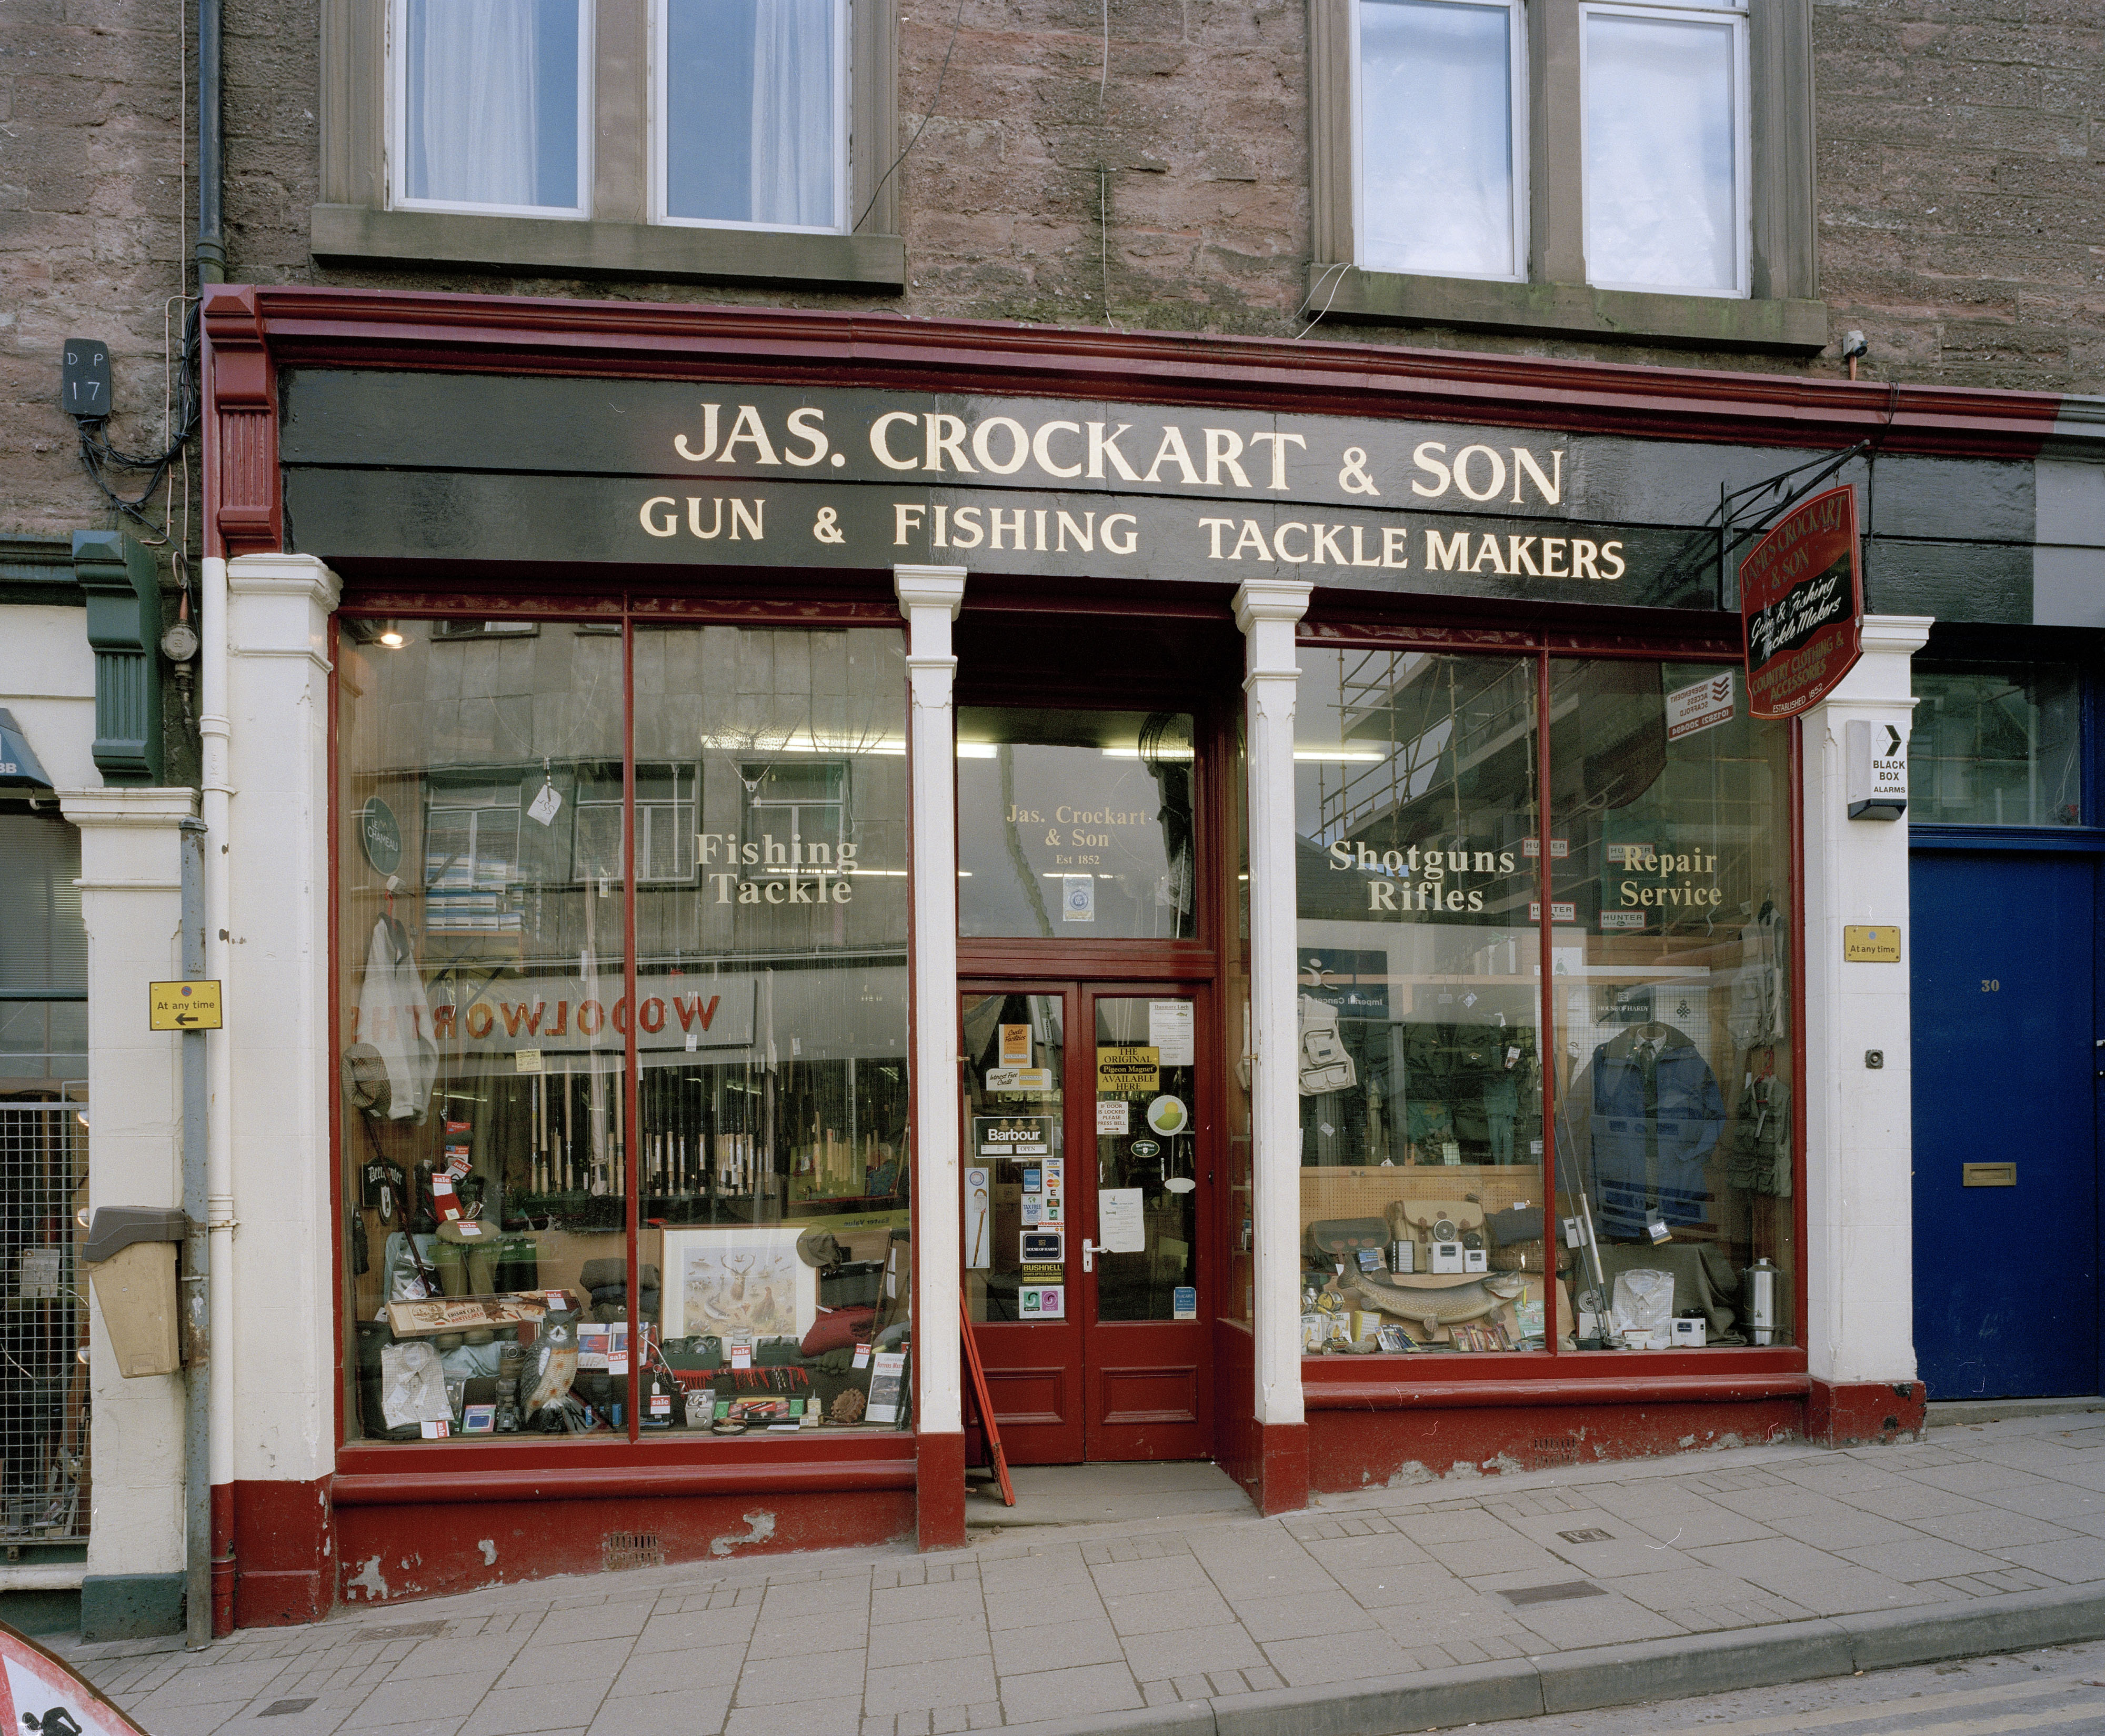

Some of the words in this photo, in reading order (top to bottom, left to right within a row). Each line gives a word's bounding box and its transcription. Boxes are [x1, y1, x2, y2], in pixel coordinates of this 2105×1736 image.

[674, 404, 845, 467] JAS.
[869, 412, 1306, 490] CROCKART
[1339, 447, 1380, 495] &
[1412, 441, 1563, 505] SON
[639, 497, 765, 540] GUN
[814, 507, 845, 544] &
[893, 504, 1137, 555] FISHING
[1198, 518, 1407, 569] TACKLE
[1425, 530, 1625, 580] MAKERS
[1744, 538, 1777, 598] JAMES
[1778, 495, 1846, 554] CROCKART
[1783, 543, 1809, 583] SON
[1777, 601, 1786, 623] &
[1791, 576, 1838, 619] Fishing
[1761, 618, 1796, 659] Tackle
[1797, 597, 1840, 634] Makers
[1752, 661, 1789, 696] COUNTRY
[1791, 636, 1833, 674] CLOTHING
[1836, 631, 1844, 649] &
[1770, 659, 1826, 704] ACCESSORIES
[1773, 695, 1806, 713] ESTABLISHED
[1809, 683, 1823, 699] 1852
[1873, 760, 1905, 769] BLACK
[1879, 772, 1899, 780] BOX
[1006, 805, 1045, 822] Jas.
[1056, 806, 1147, 825] Crockart
[368, 826, 398, 852] CHAMEAU
[1045, 828, 1060, 846] &
[1072, 829, 1109, 847] Son
[695, 834, 858, 872] Fishing
[1056, 855, 1072, 864] Est
[1078, 855, 1100, 865] 1852
[1329, 841, 1515, 880] Shotguns
[1623, 847, 1718, 877] Repair
[709, 874, 851, 904] Tackle
[1367, 881, 1483, 912] Rifles
[1620, 881, 1722, 907] Service
[1860, 946, 1876, 955] any
[1981, 979, 1999, 992] 30
[157, 1001, 168, 1010] At
[172, 1001, 188, 1012] any
[192, 1000, 215, 1009] time
[988, 1129, 1040, 1141] Barbour
[453, 1161, 468, 1172] sale
[437, 1422, 446, 1437] sale
